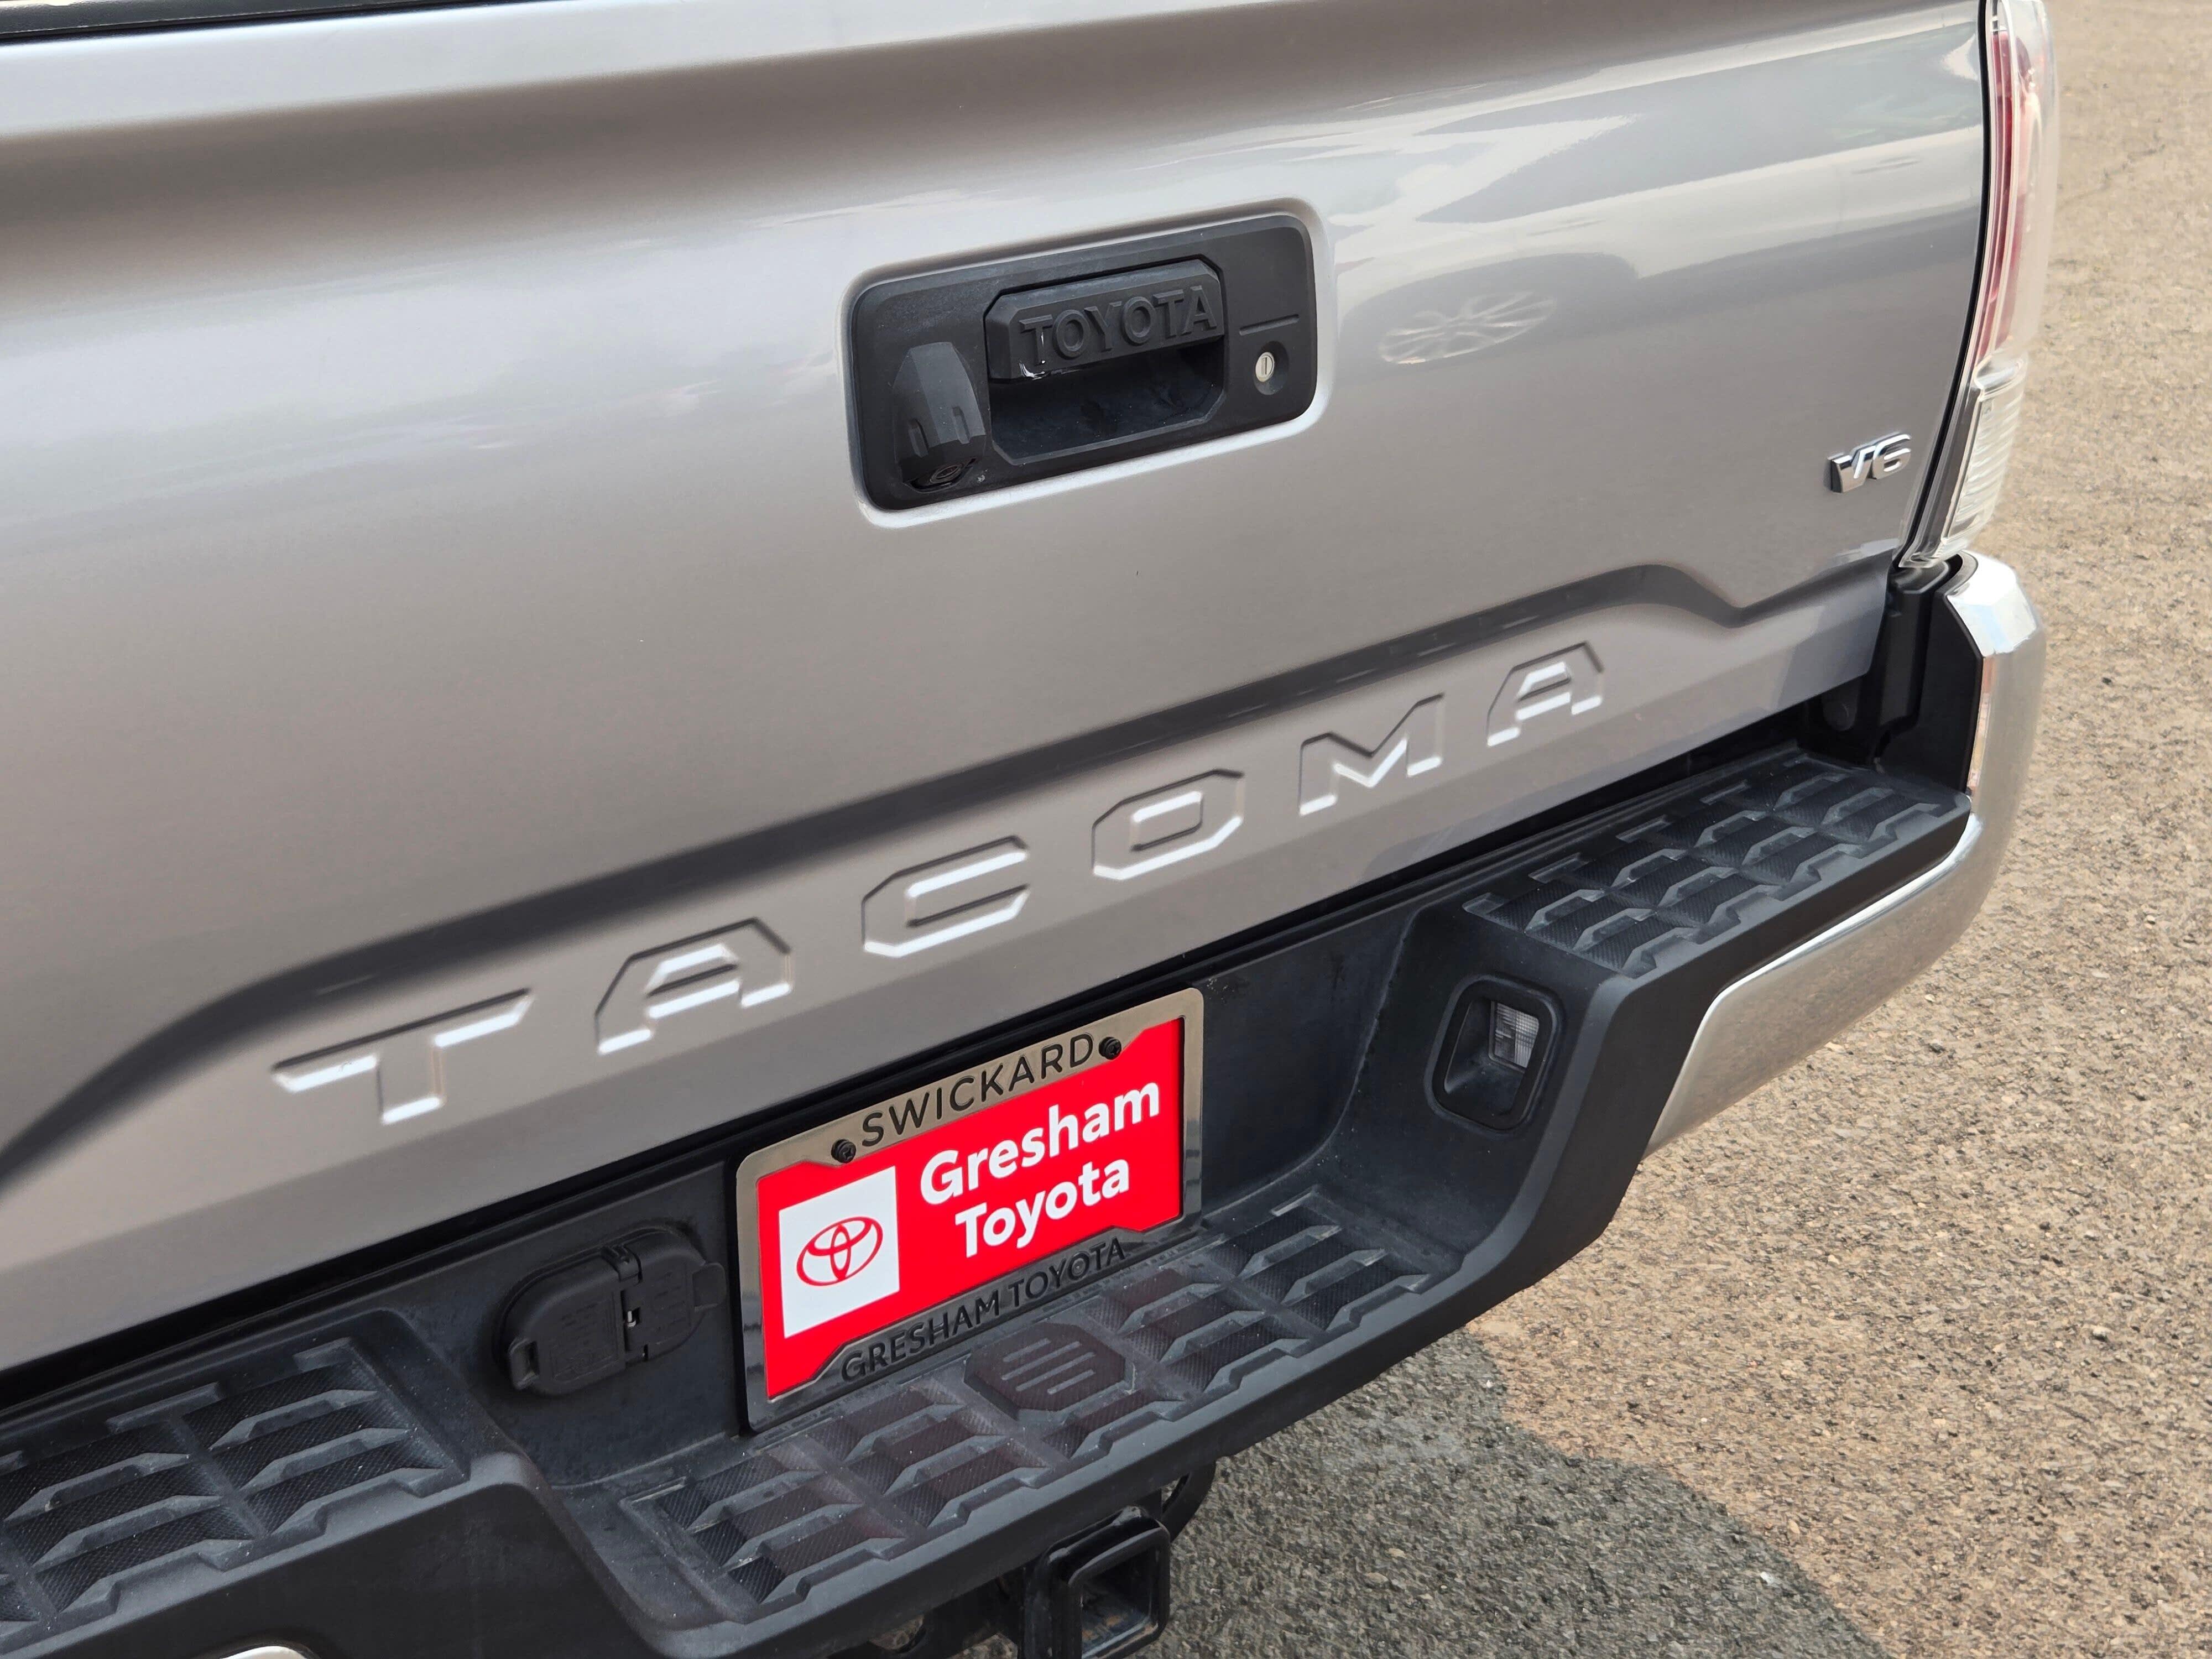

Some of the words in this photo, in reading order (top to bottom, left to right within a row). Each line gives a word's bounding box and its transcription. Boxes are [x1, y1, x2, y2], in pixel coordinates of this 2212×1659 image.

[1019, 285, 1217, 367] TOYOTA
[1827, 432, 1911, 493] V6
[270, 641, 1605, 1126] TACOMA
[860, 1033, 1095, 1148] SWICKARD
[920, 1082, 1160, 1205] Gresham
[954, 1159, 1129, 1259] Toyota
[841, 1288, 1000, 1383] GRESHAM
[1008, 1237, 1126, 1307] TOYOTA
